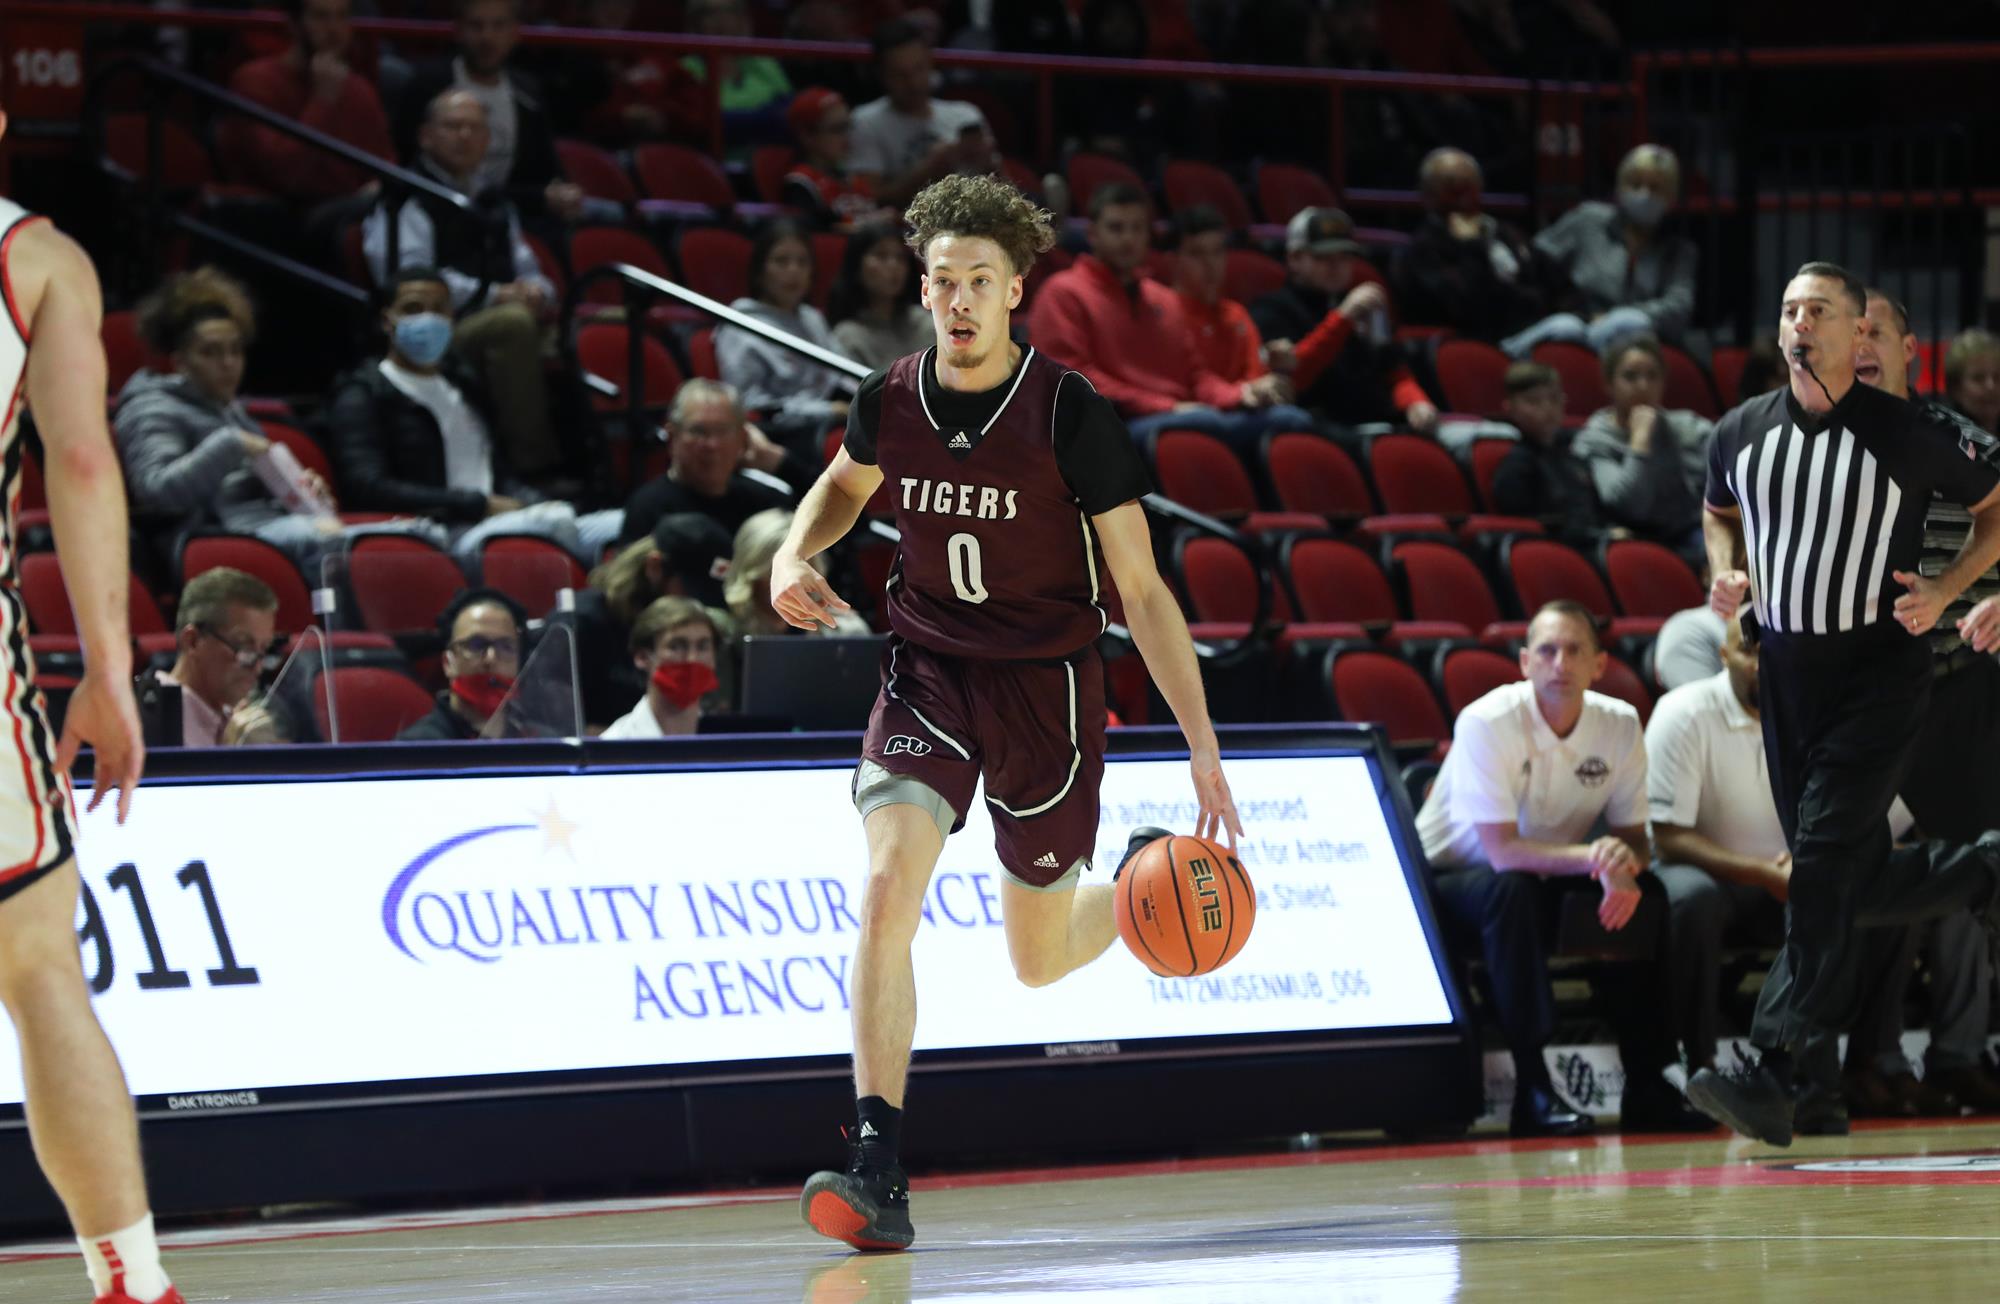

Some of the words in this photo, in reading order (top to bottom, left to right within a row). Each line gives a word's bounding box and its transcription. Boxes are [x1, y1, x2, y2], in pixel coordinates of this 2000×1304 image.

[948, 441, 971, 449] adidas
[900, 477, 1019, 520] TIGERS
[947, 532, 989, 604] 0
[1240, 794, 1309, 822] censed
[1033, 860, 1060, 868] adidas
[1188, 858, 1223, 931] ELITE
[412, 883, 662, 963] QUALITY
[679, 871, 1004, 939] INSURCE
[633, 955, 848, 1021] AGENCY
[167, 1091, 259, 1110] DAKTRONICS
